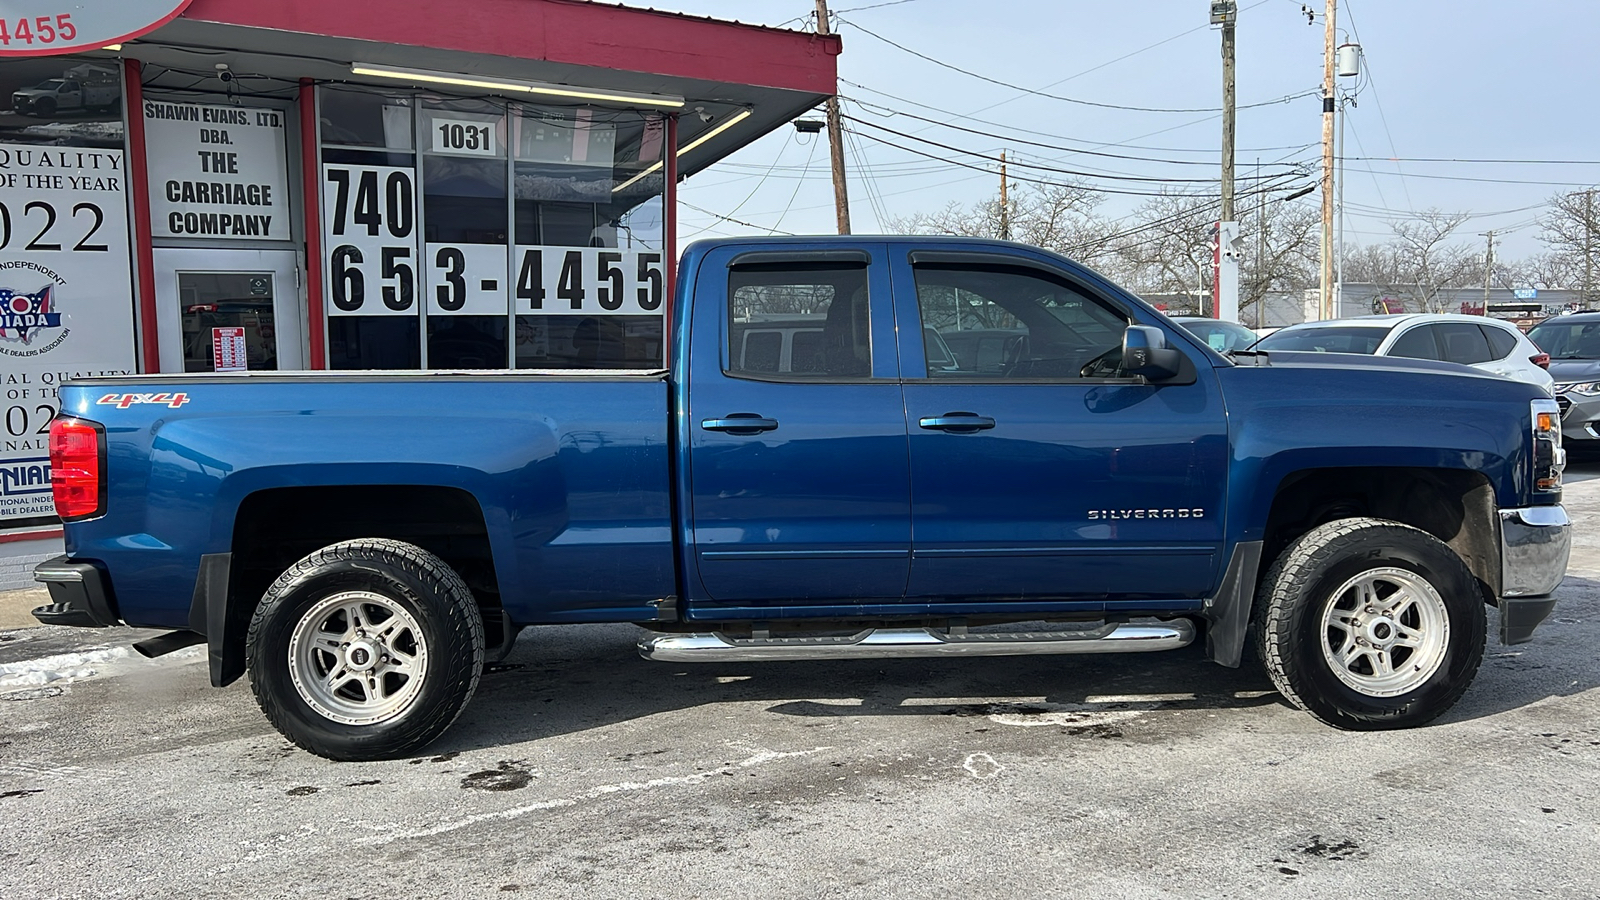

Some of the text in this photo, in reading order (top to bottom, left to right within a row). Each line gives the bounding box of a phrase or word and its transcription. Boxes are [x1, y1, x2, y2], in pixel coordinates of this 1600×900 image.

[0, 13, 77, 45] 4455
[145, 104, 199, 121] SHAWN
[256, 112, 283, 128] LTD.
[200, 128, 233, 145] DBA.
[438, 124, 490, 151] 1031
[198, 150, 238, 174] THE
[22, 174, 63, 189] THE
[68, 175, 120, 191] YEAR
[166, 180, 272, 206] CARRIAGE
[327, 168, 413, 238] 740
[168, 211, 272, 236] COMPANY
[10, 349, 39, 357] DEALERS
[39, 327, 70, 355] ASSOCIATION
[7, 388, 58, 400] OF TH
[6, 404, 56, 437] 02
[0, 505, 54, 516] BILE DEALERS
[1087, 508, 1205, 519] SILVERADO
